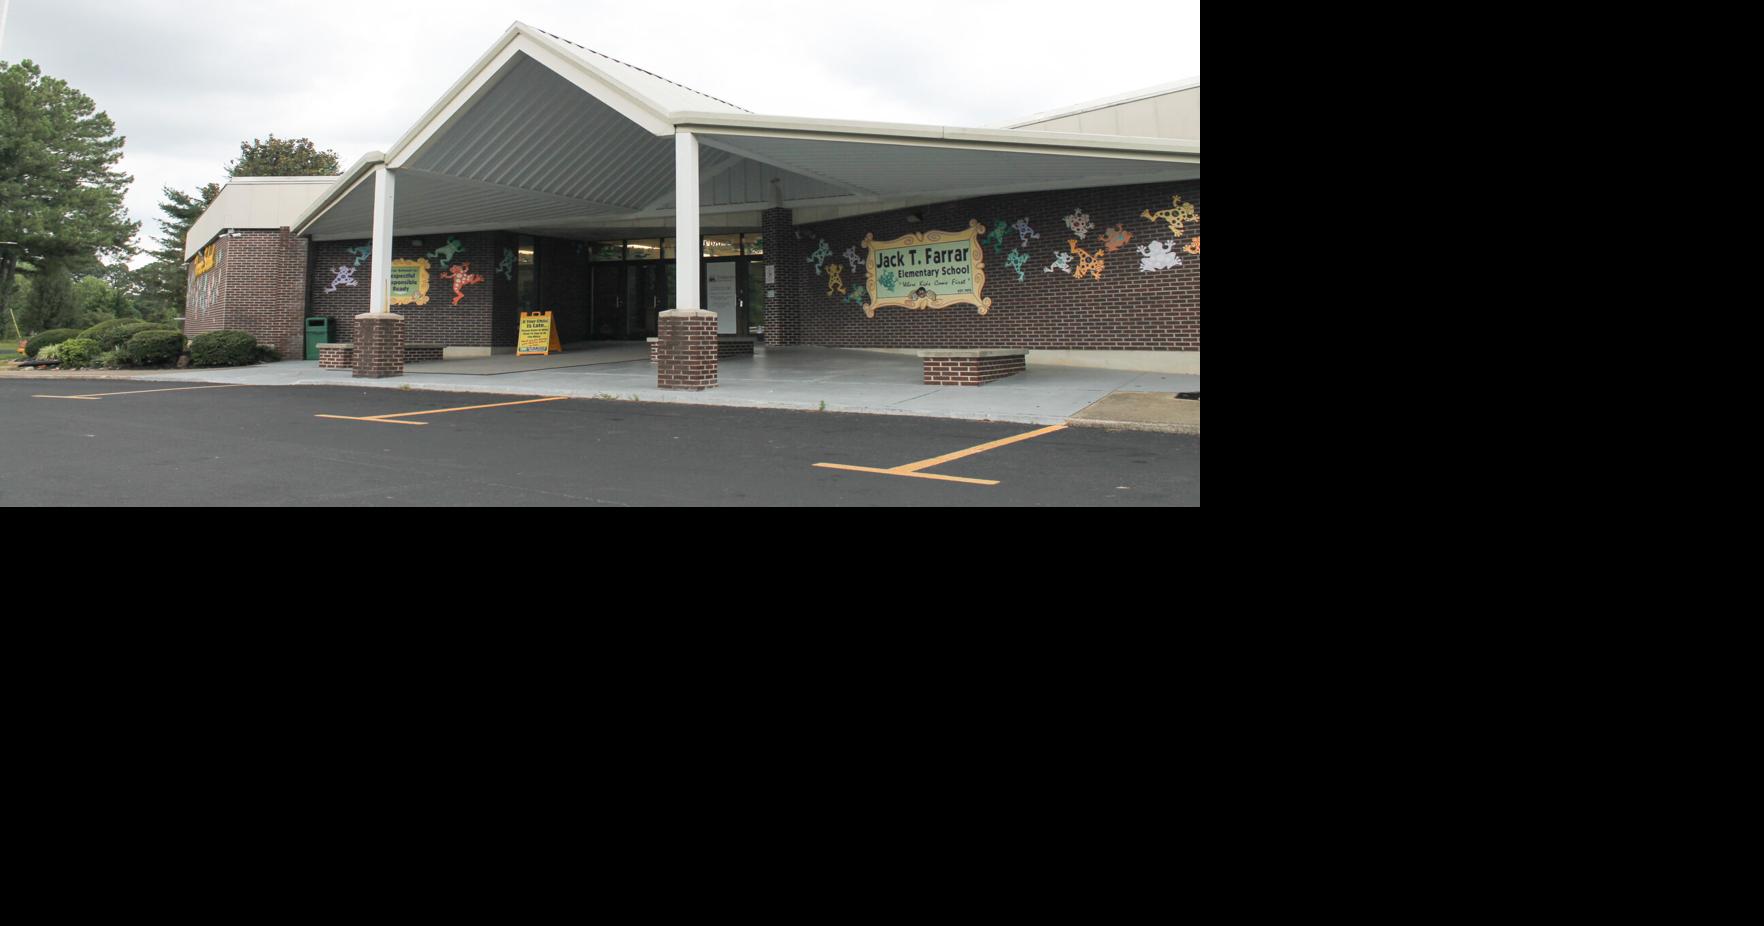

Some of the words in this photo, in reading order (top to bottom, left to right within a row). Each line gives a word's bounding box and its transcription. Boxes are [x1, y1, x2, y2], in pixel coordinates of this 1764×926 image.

[876, 250, 905, 269] Jack
[908, 249, 922, 266] T.
[925, 247, 970, 265] Farrar
[898, 268, 940, 278] Elementary
[941, 265, 970, 276] School
